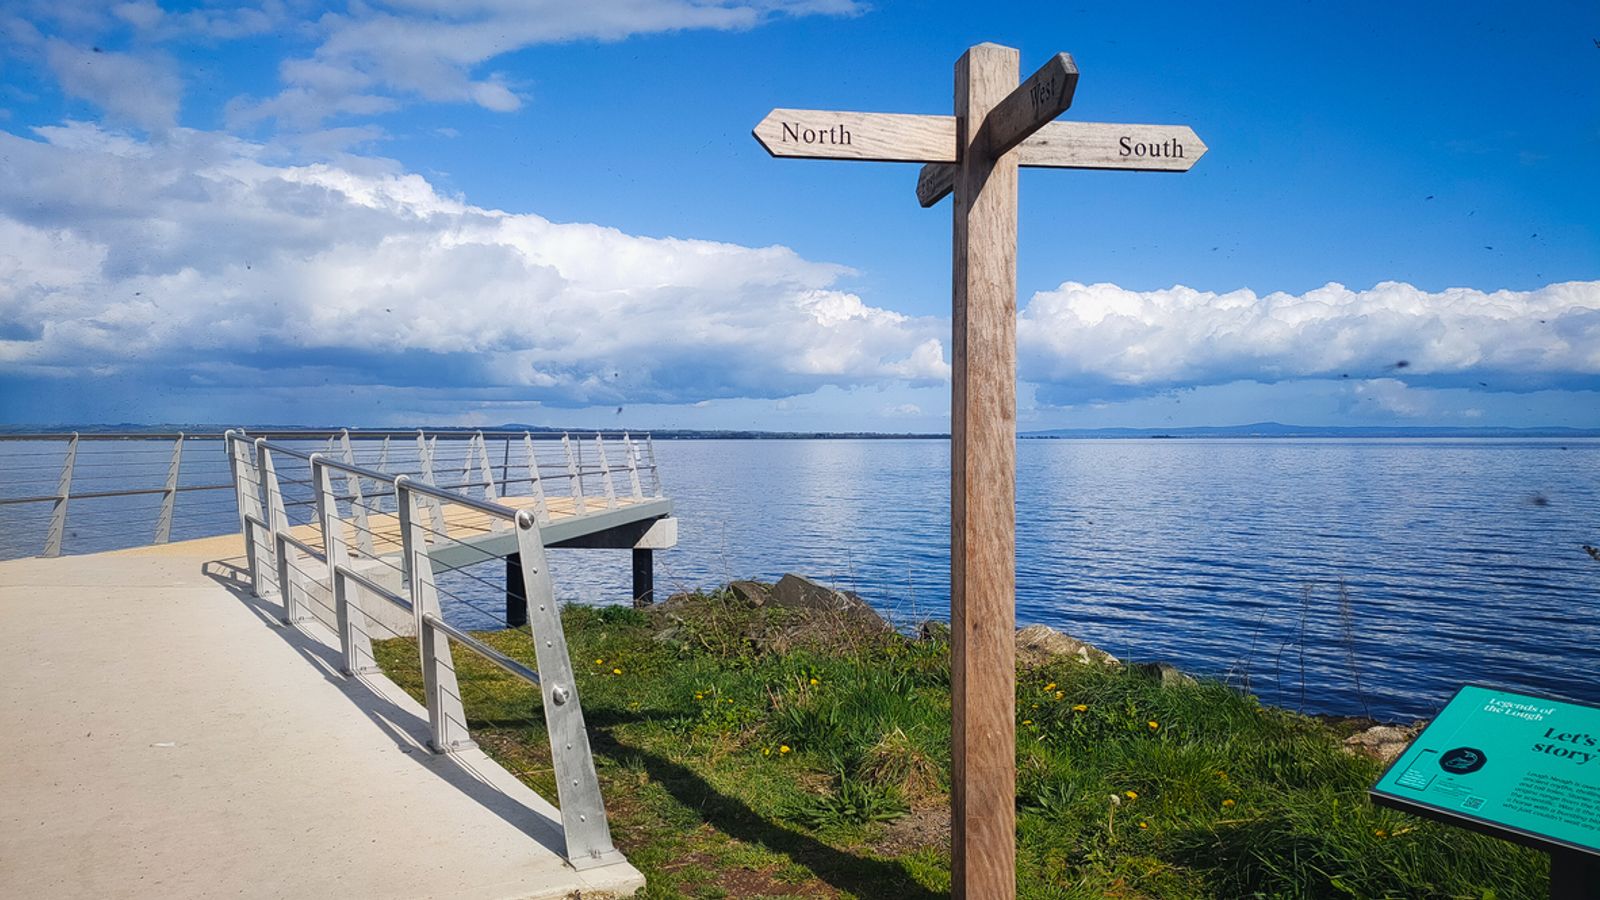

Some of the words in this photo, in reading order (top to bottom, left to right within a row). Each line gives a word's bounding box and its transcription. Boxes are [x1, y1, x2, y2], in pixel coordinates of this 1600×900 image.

[1030, 77, 1055, 107] West
[781, 121, 852, 144] North
[1119, 136, 1184, 158] South
[1484, 705, 1504, 714] the
[1504, 709, 1543, 721] Lough
[1490, 698, 1537, 713] Legends
[1539, 708, 1556, 716] of
[1544, 727, 1597, 747] Let's
[1532, 743, 1597, 765] story
